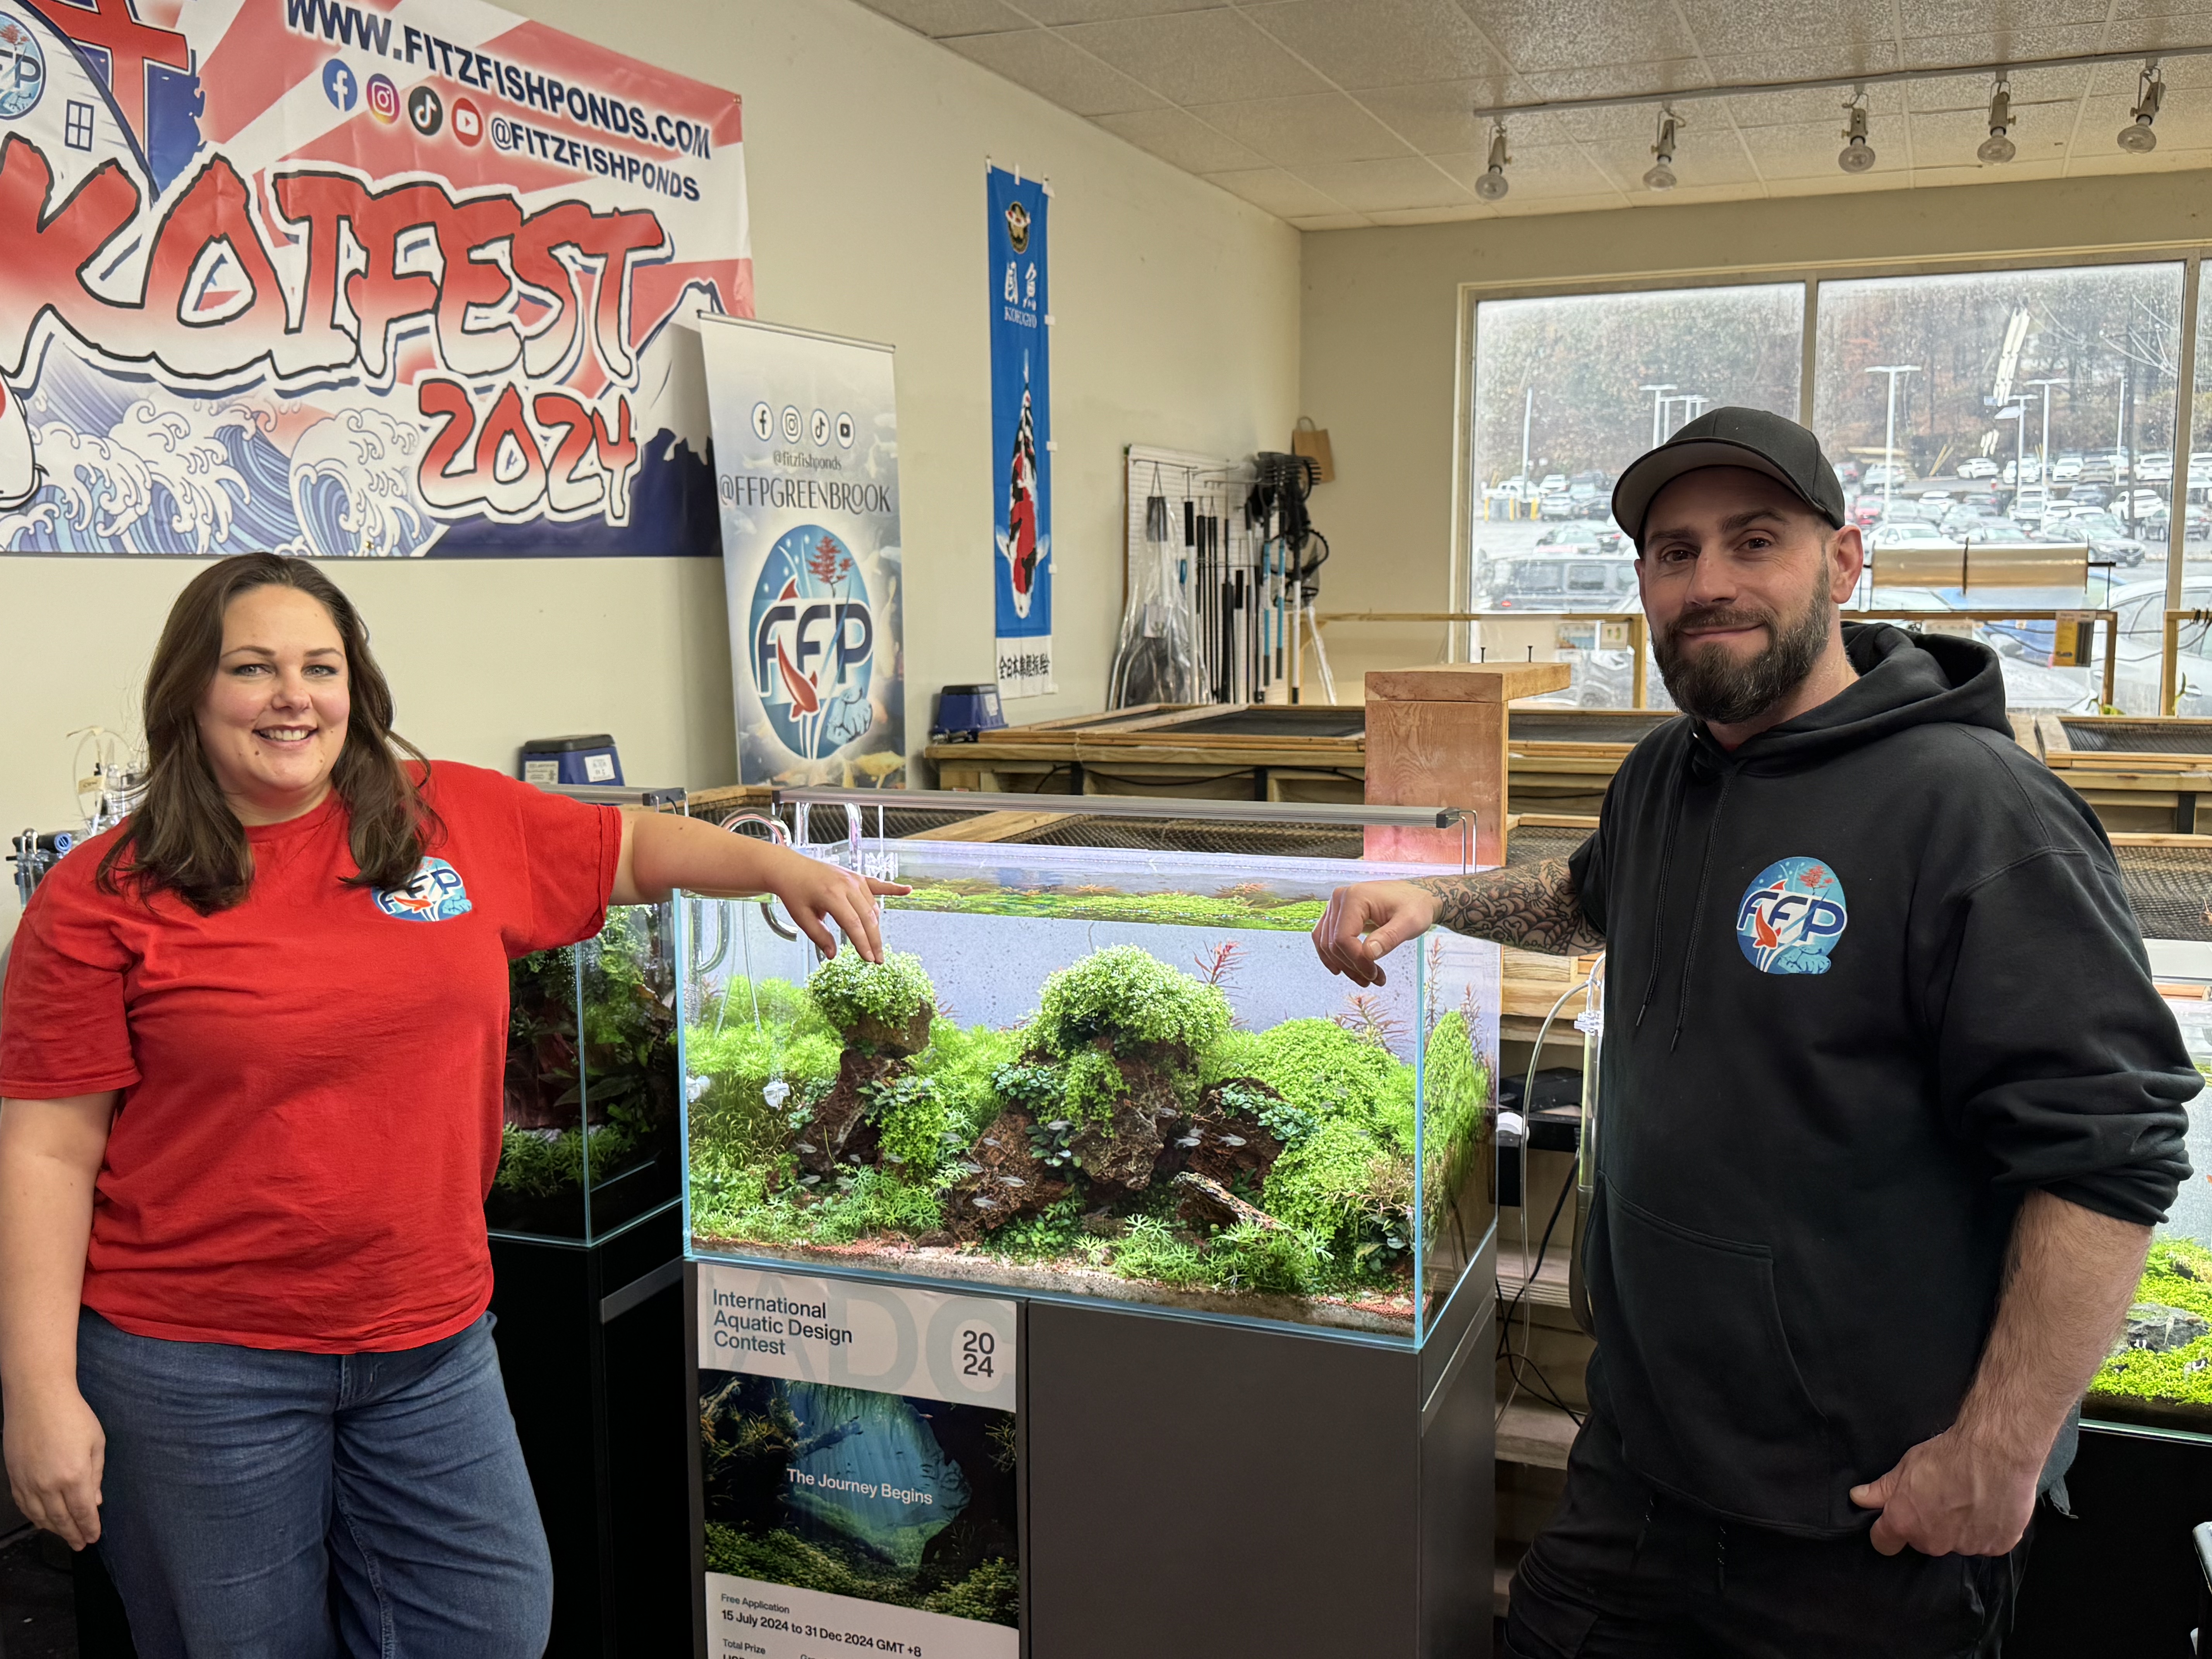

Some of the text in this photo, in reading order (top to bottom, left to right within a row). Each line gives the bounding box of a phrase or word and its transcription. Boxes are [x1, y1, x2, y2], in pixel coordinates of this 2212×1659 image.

[288, 0, 711, 160] WWW.FITZFISHPONDS.COM
[491, 117, 700, 201] @FITZFISHPONDS
[418, 380, 637, 524] 2024
[773, 450, 842, 471] @fitzfishponds
[720, 474, 891, 515] @FFPGREENBROOK
[758, 603, 873, 693] FFP
[1738, 890, 1846, 943] FFP
[713, 1289, 826, 1319] International
[713, 1310, 852, 1345] Aquatic Design
[714, 1330, 786, 1356] Contest
[962, 1329, 995, 1355] 20
[963, 1353, 994, 1378] 24
[787, 1468, 933, 1505] The Journey Begins
[721, 1593, 790, 1614] Free Application
[722, 1609, 922, 1657] 15 July 2024 to 31 Dec 2024 GMT +8
[723, 1638, 766, 1655] Total Prize
